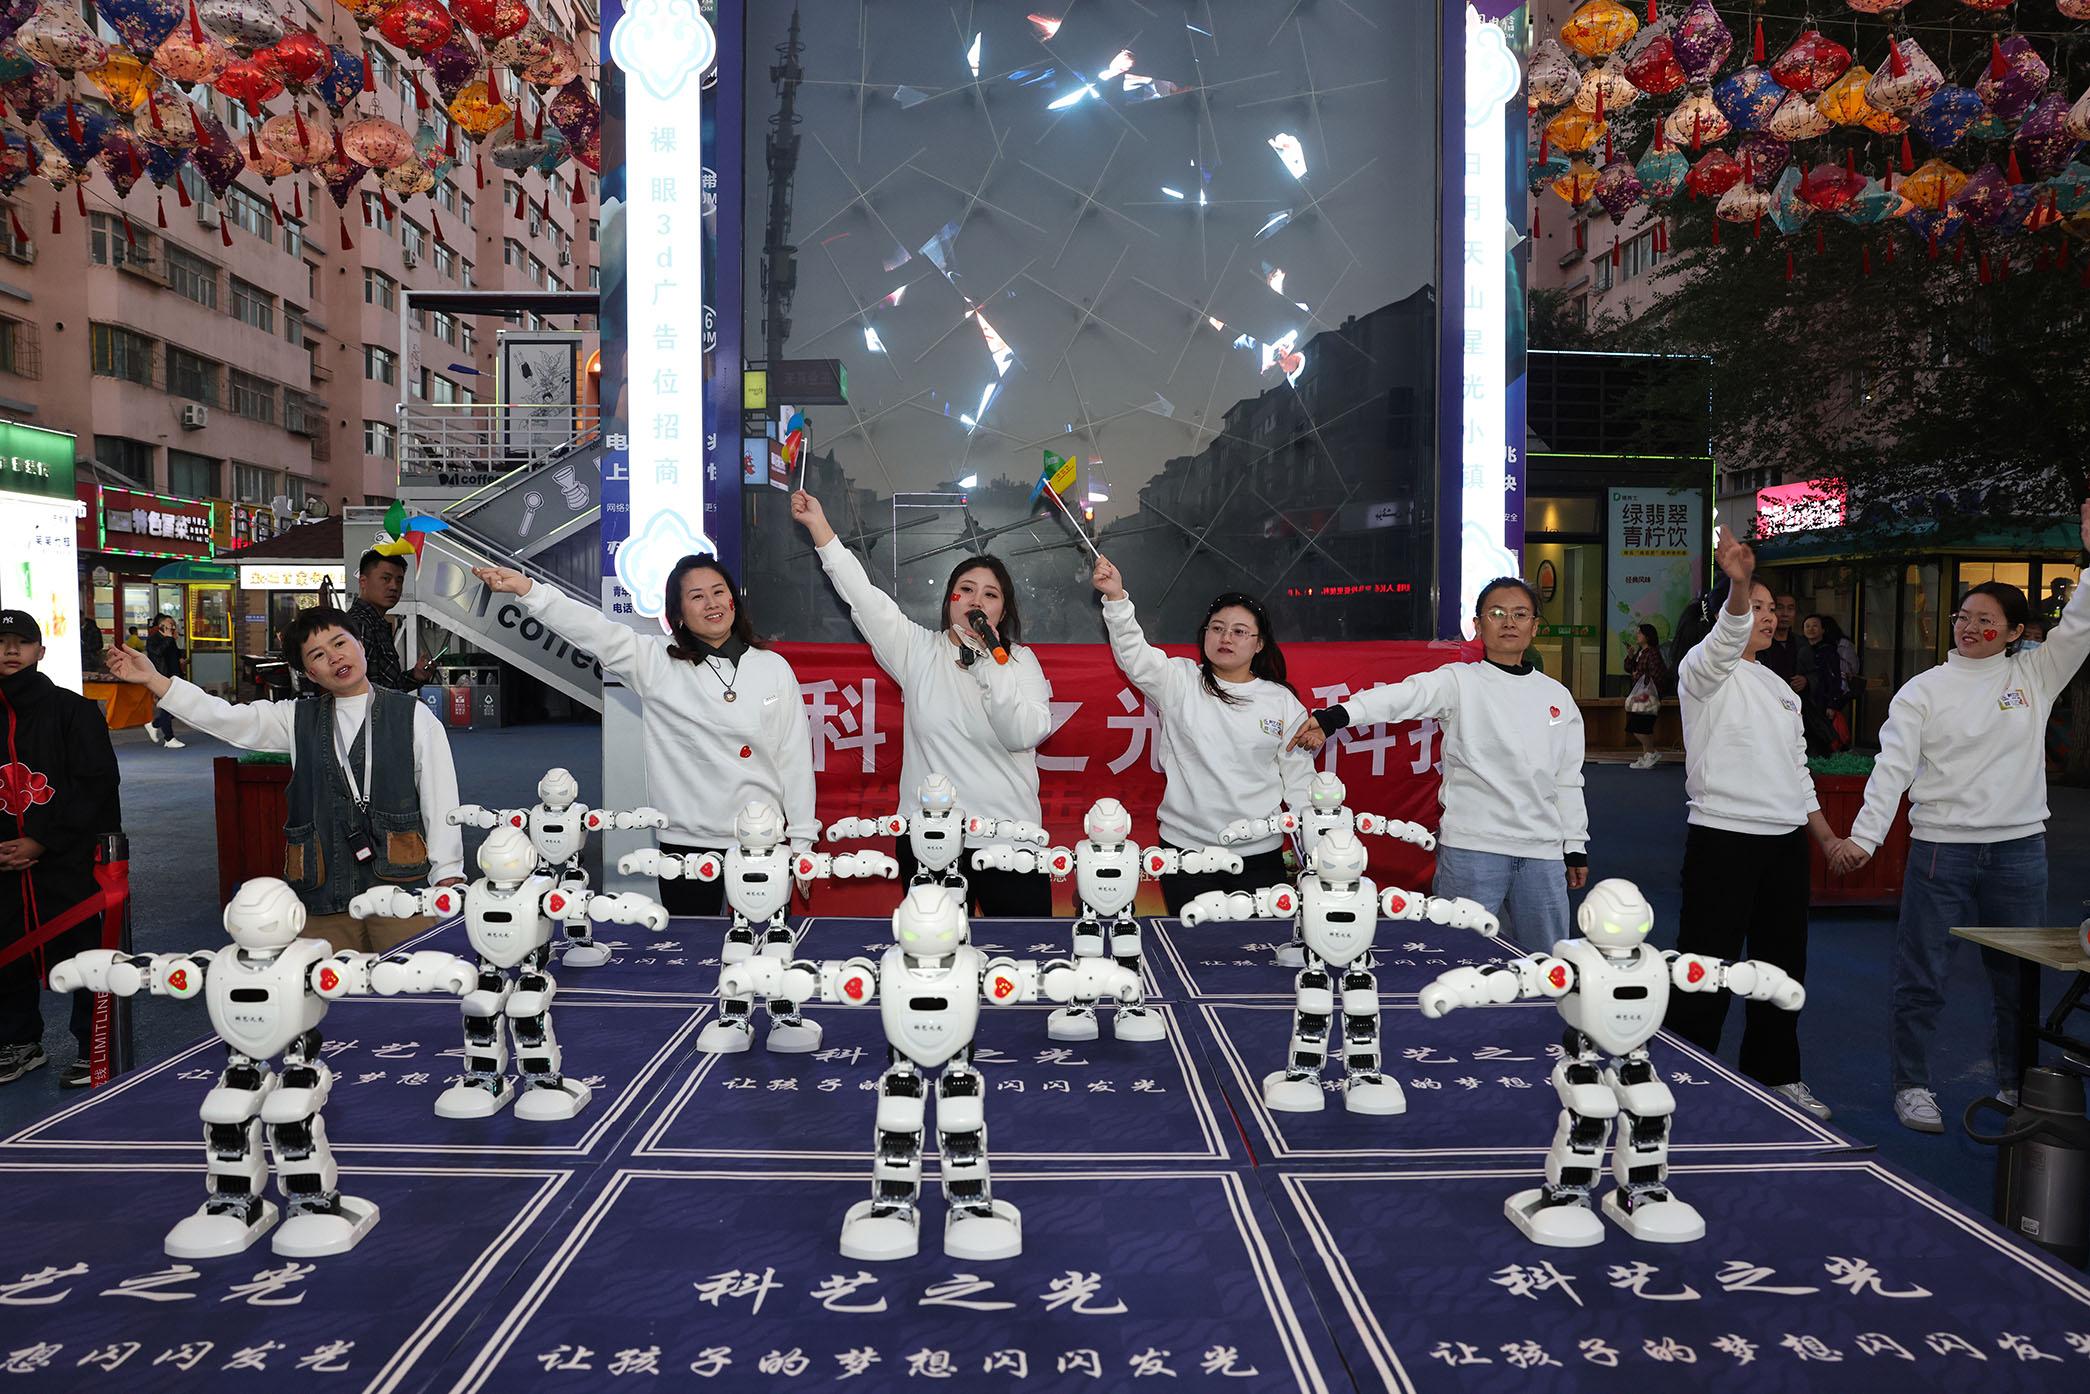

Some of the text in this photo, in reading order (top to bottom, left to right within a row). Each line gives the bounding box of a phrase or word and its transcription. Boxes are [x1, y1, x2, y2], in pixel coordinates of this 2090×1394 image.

[650, 126, 680, 485] 裸眼3d广告位招商
[1622, 504, 1688, 526] 绿翡翠
[1623, 526, 1688, 548] 青柠饮
[693, 1266, 1129, 1315] 科艺之光
[1489, 1256, 1933, 1306] 科艺之光
[537, 1344, 1259, 1380] 让孩子的梦想闪闪发光
